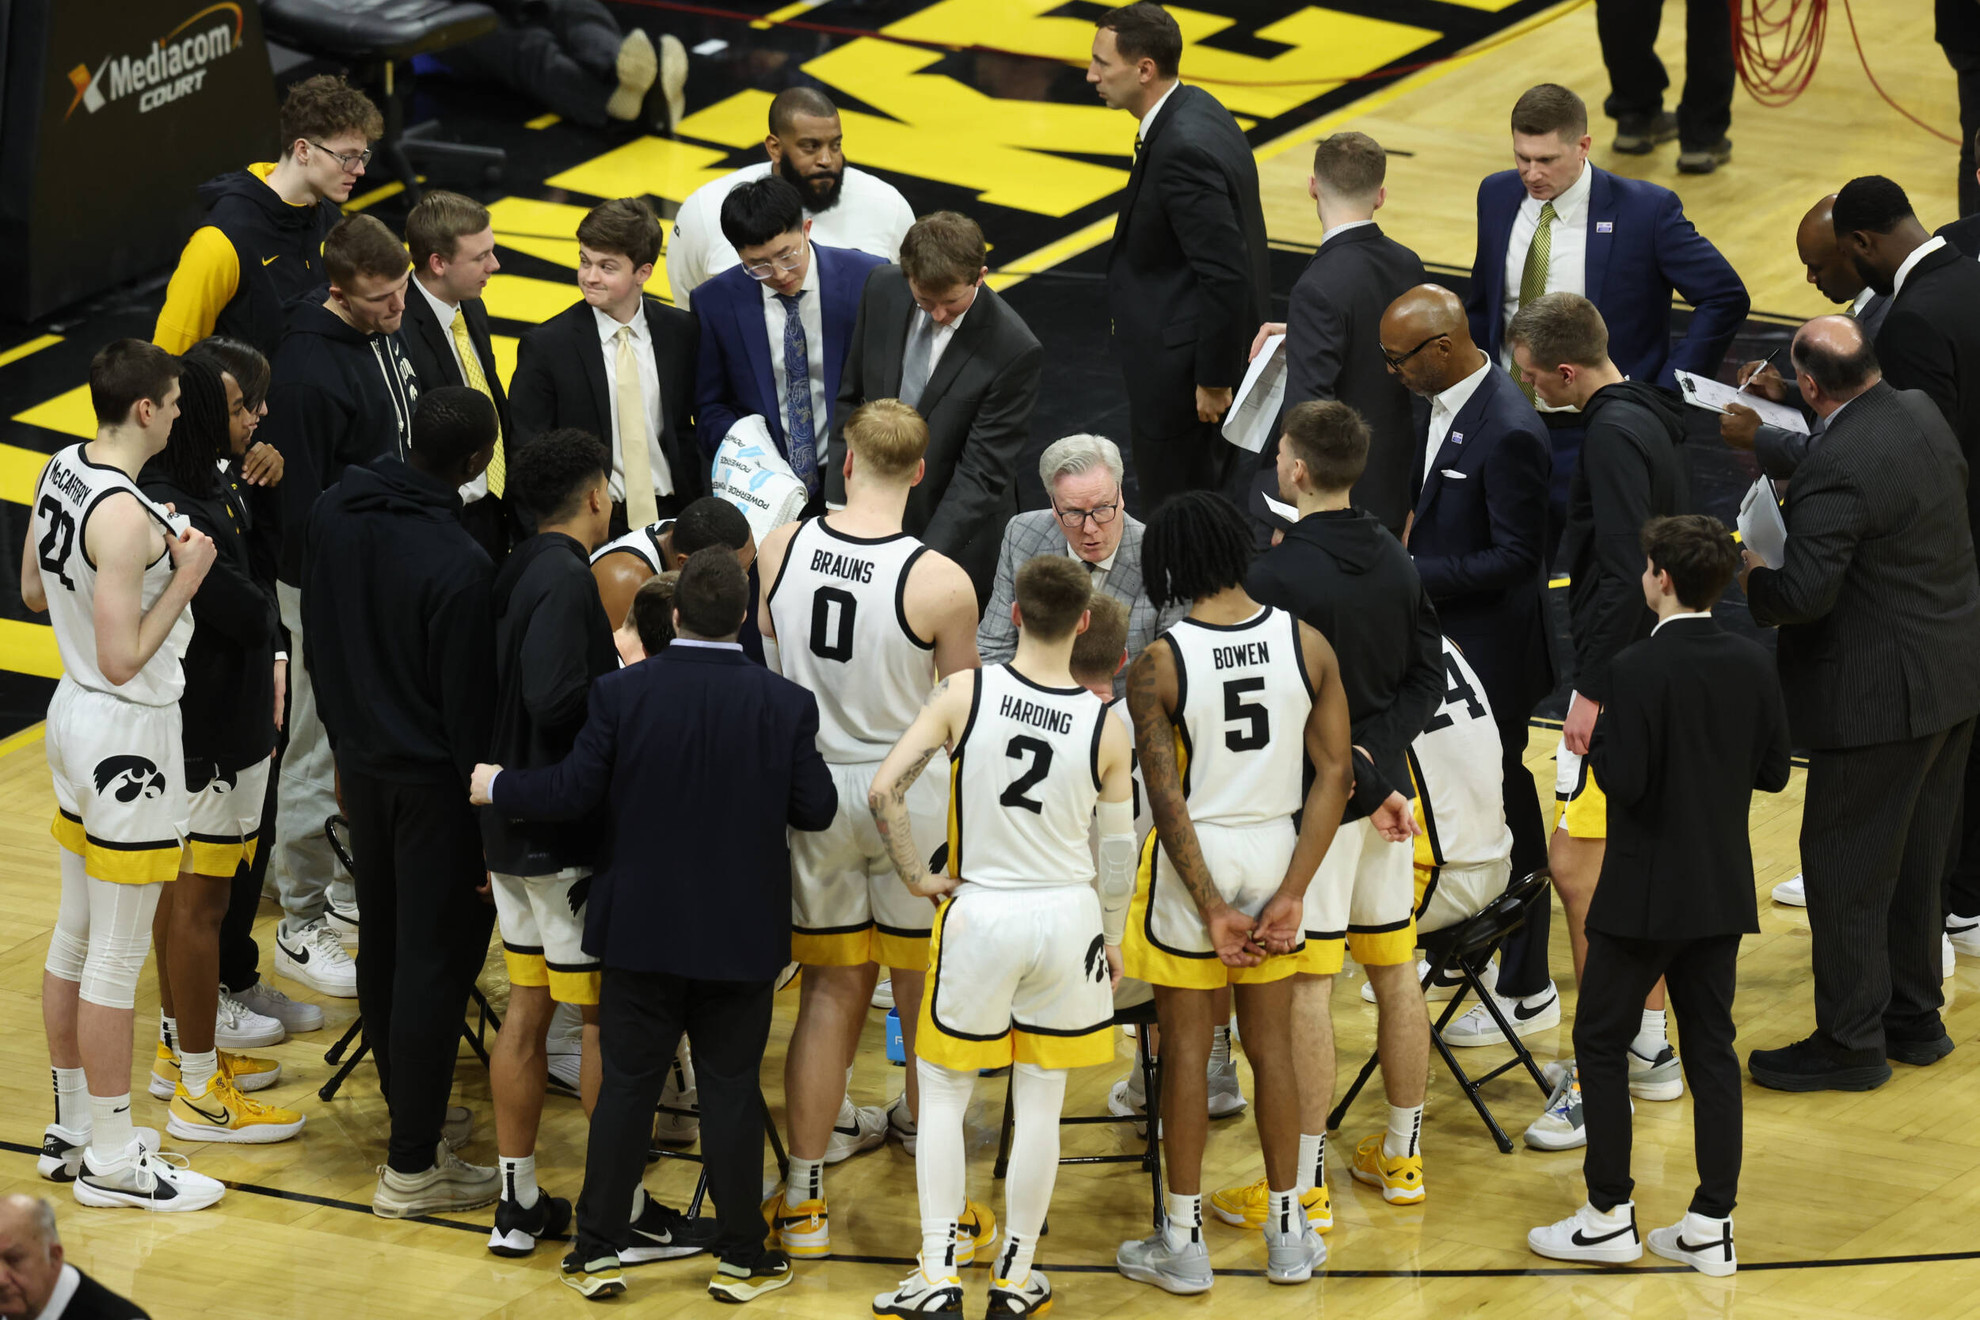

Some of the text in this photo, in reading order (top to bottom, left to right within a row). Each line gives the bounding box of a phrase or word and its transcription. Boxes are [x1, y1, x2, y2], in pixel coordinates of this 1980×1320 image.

[109, 24, 232, 101] Mediacom
[139, 69, 207, 113] COURT
[727, 485, 770, 510] POWERADE
[810, 549, 875, 584] BRAUNS
[809, 585, 858, 664] 0
[1212, 641, 1270, 670] BOWEN
[1000, 694, 1073, 735] HARDING
[1222, 676, 1271, 753] 5
[1000, 734, 1054, 815] 2
